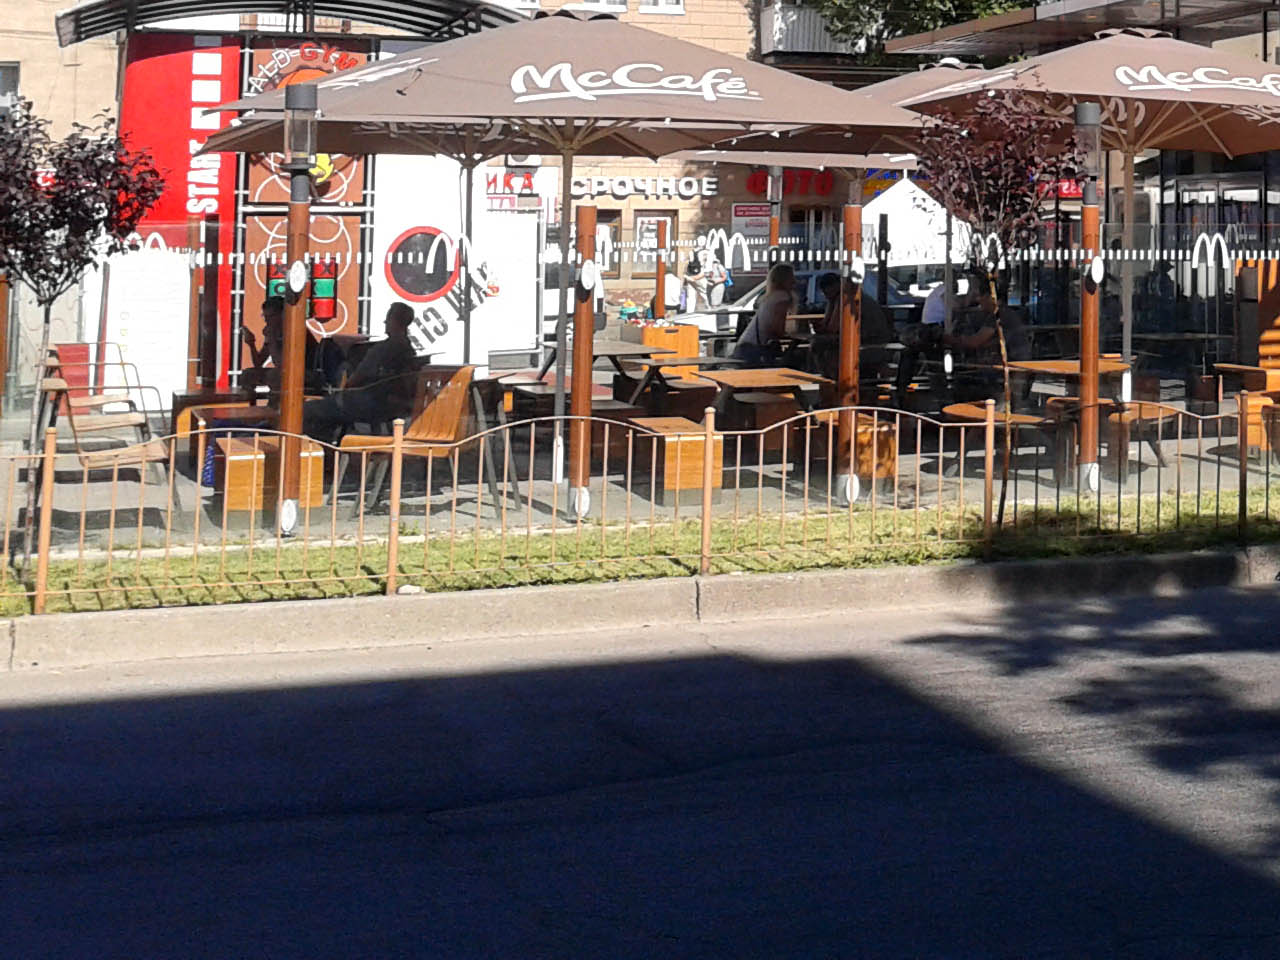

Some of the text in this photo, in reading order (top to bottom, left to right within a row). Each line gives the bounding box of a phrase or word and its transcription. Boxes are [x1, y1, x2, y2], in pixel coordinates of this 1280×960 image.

[510, 62, 764, 103] McCafé
[486, 172, 534, 194] ИКА
[570, 175, 719, 198] СРОЧНОЕ
